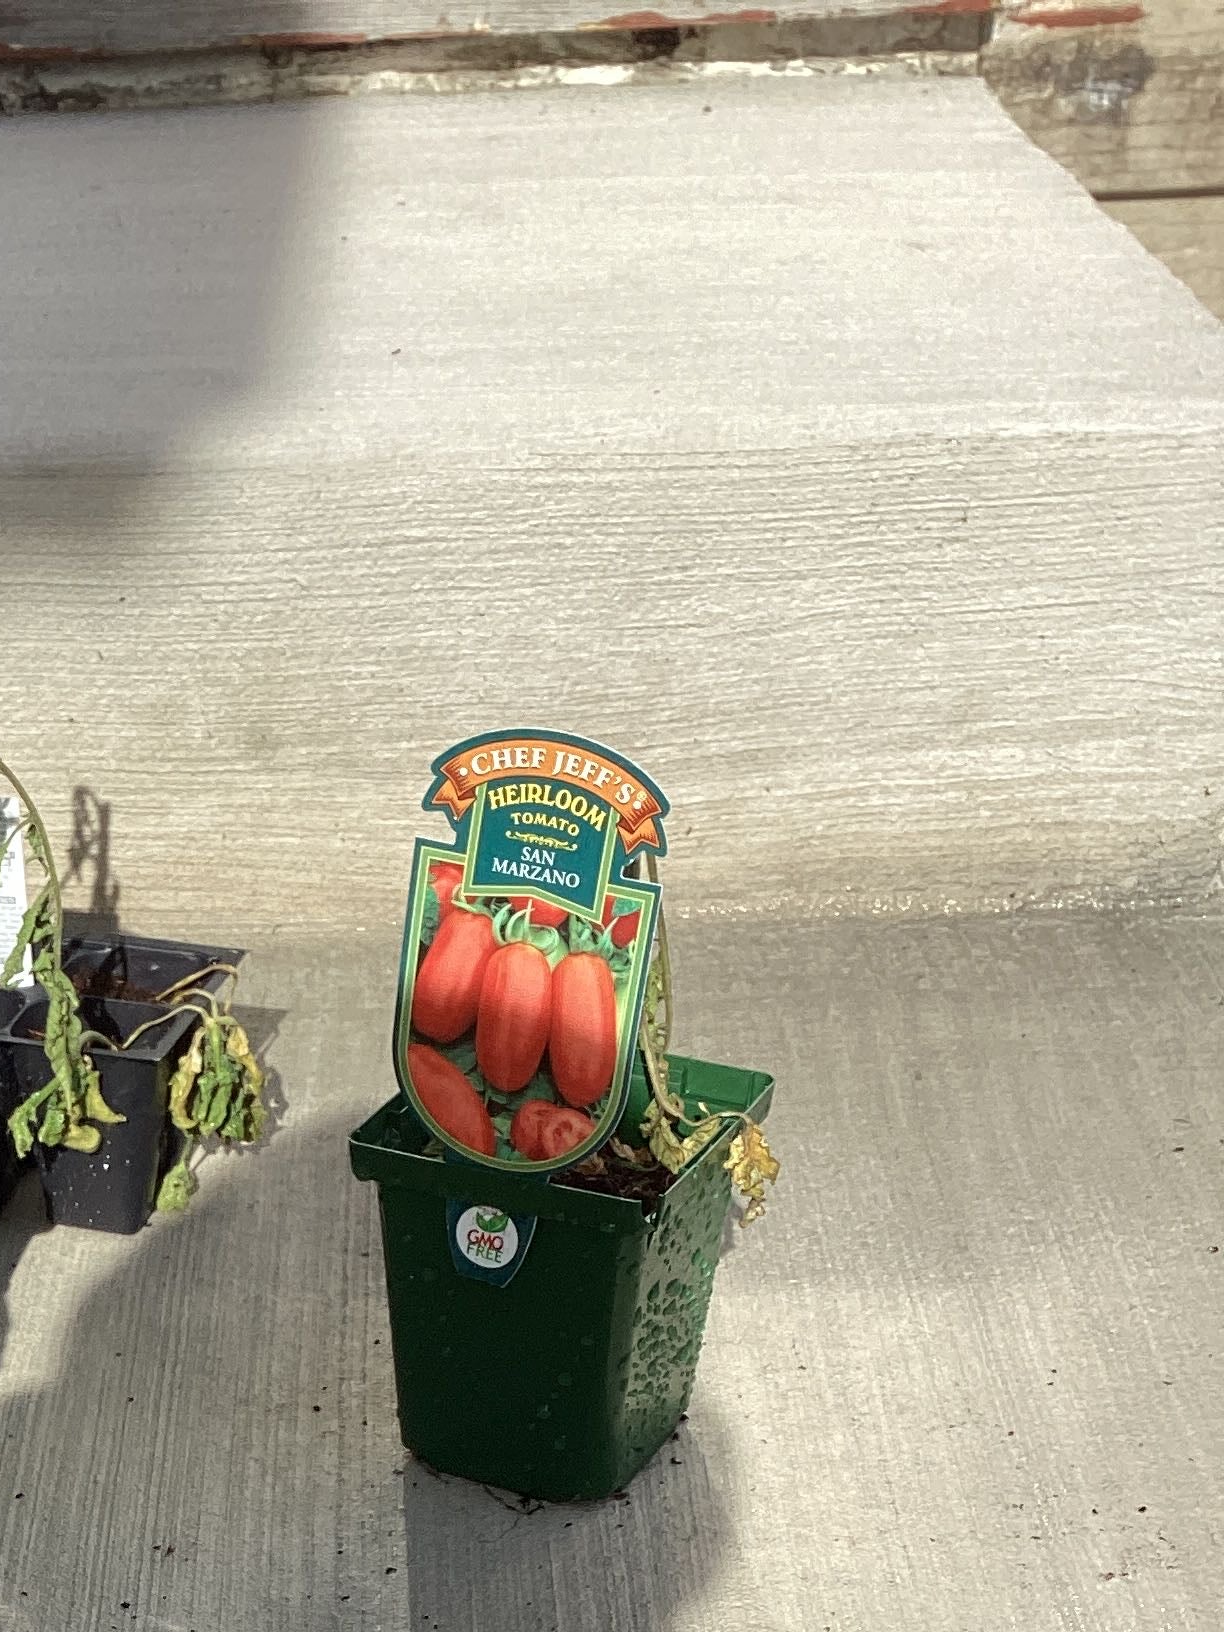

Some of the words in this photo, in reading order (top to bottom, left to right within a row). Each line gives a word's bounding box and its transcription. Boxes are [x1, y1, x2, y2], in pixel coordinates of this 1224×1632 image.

[471, 747, 547, 775] CHEF
[488, 783, 608, 833] HEIRLOOM
[510, 812, 580, 837] TOMATO
[520, 846, 556, 867] SAN
[491, 857, 581, 889] MARZANO
[467, 1228, 504, 1251] GMO
[466, 1241, 504, 1264] FREE
